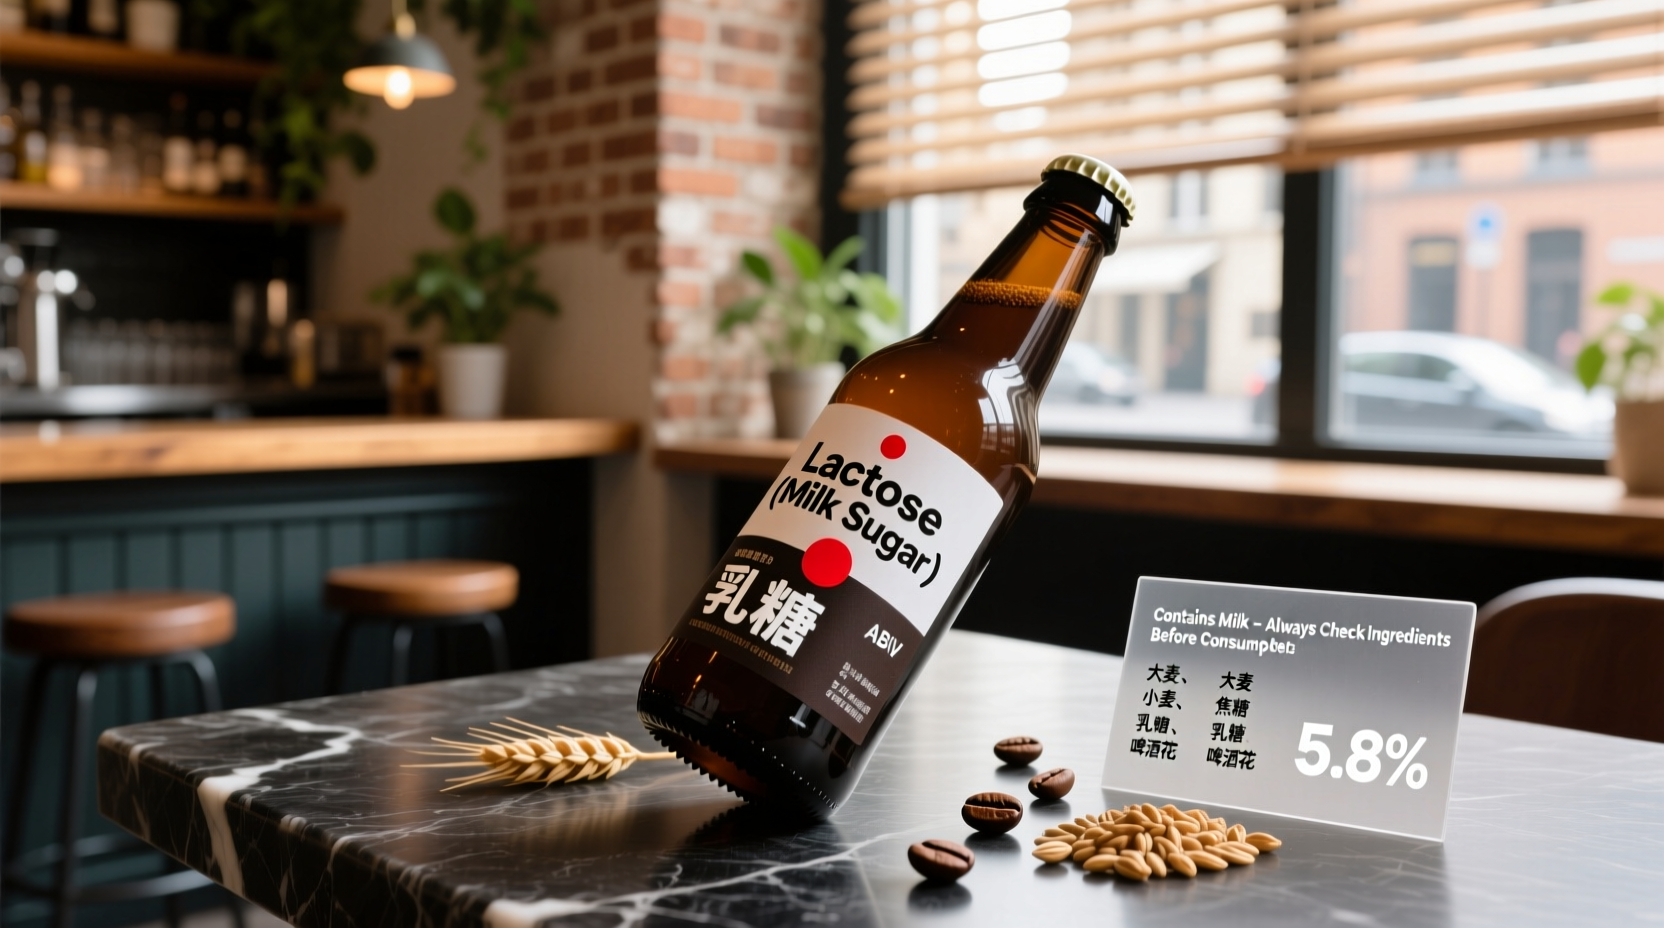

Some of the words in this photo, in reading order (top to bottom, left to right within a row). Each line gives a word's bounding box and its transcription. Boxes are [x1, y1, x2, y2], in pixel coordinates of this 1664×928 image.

[801, 441, 942, 536] Lactose
[769, 475, 842, 521] (Milk
[841, 501, 941, 588] Sugar)
[702, 564, 826, 658] 乳糖
[1150, 626, 1197, 646] Before
[1153, 607, 1216, 627] Contains
[1218, 612, 1249, 630] Milk
[1264, 617, 1317, 640] Always
[1319, 621, 1366, 641] Check
[1367, 624, 1452, 648] Ingredients
[1219, 671, 1254, 692] 大麦
[1294, 721, 1428, 790] 5.8%
